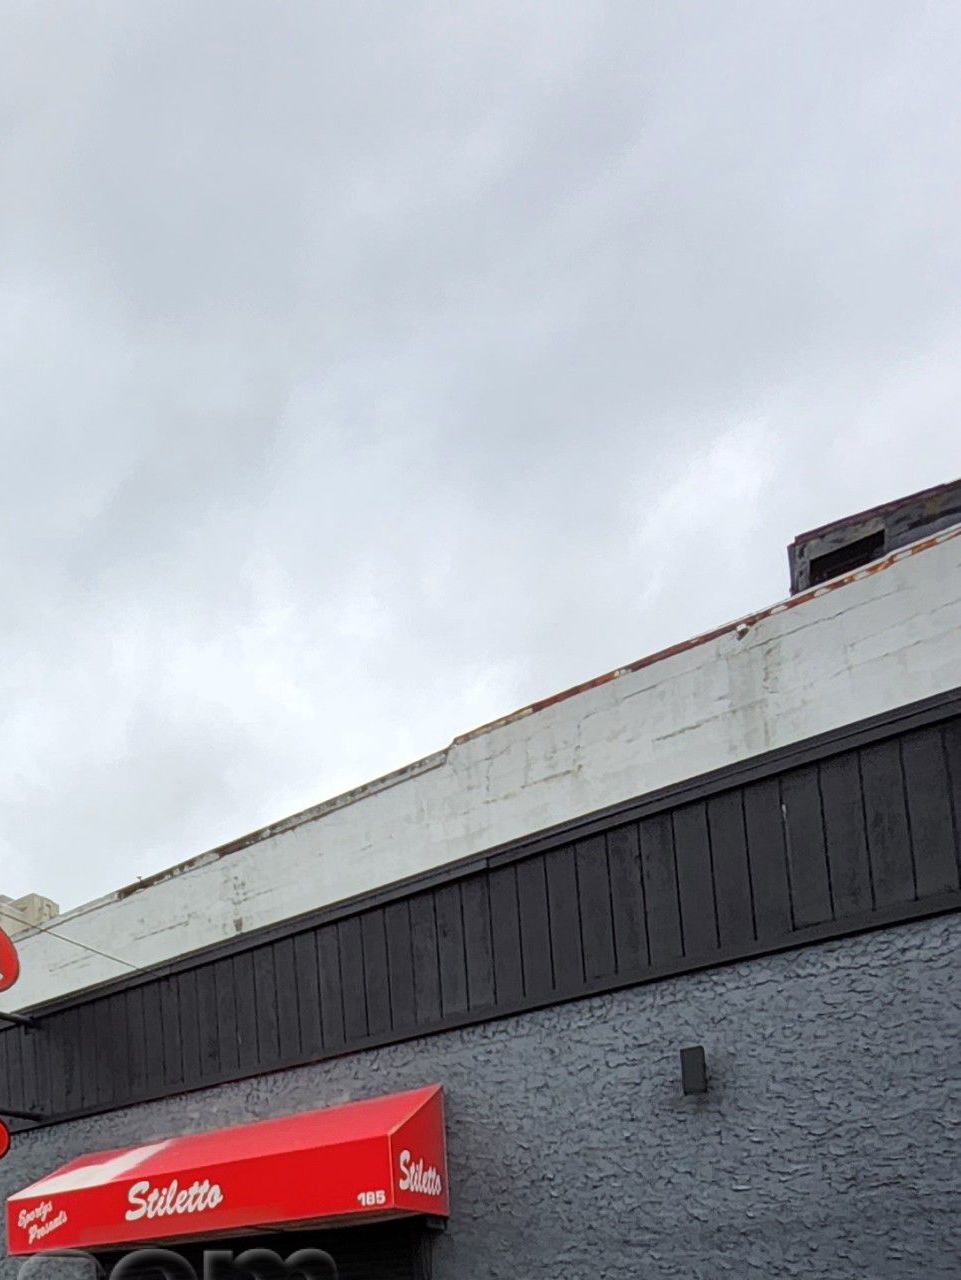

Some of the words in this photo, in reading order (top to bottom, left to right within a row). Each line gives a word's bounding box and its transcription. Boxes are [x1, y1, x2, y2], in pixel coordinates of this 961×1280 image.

[399, 1149, 442, 1196] Stiletto
[125, 1179, 223, 1221] Stiletto
[357, 1189, 386, 1207] 185
[28, 1210, 68, 1245] Presents
